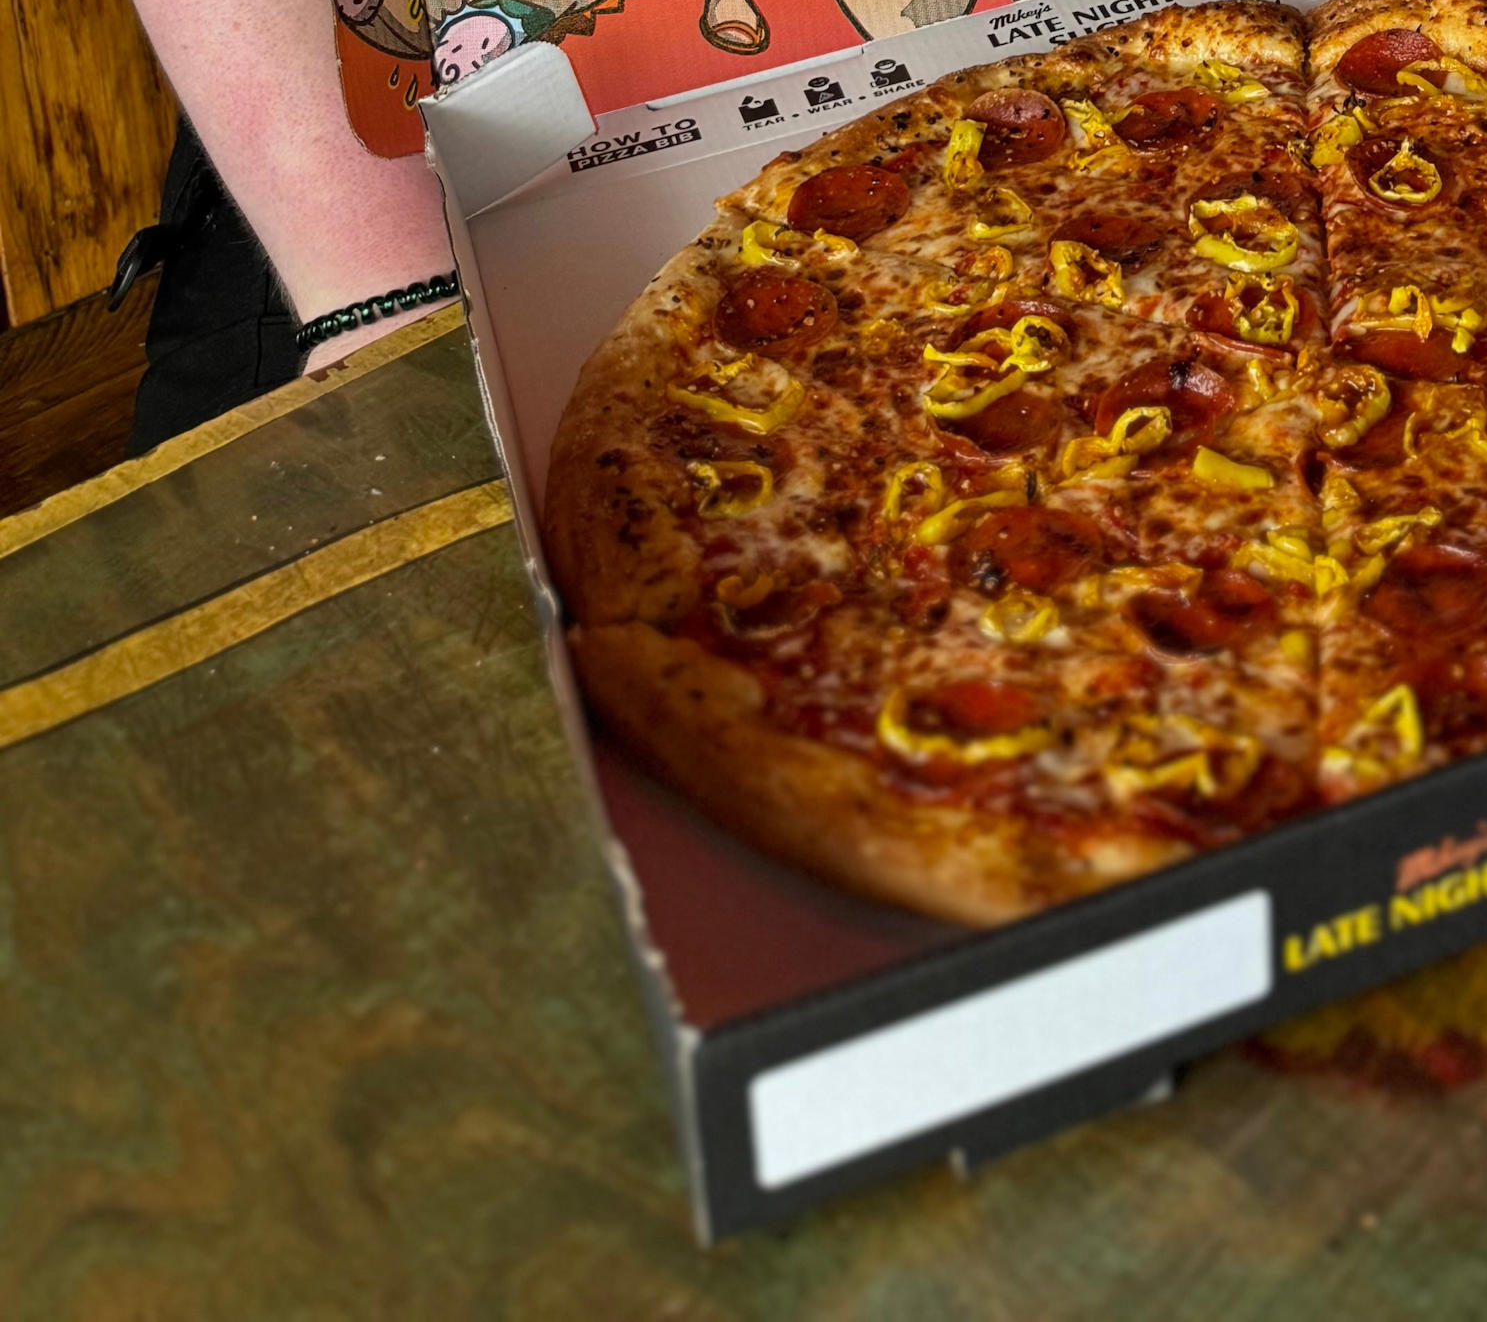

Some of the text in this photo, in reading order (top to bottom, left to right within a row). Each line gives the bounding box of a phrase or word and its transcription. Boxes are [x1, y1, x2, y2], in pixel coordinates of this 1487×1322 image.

[987, 16, 1065, 48] LATE
[989, 2, 1052, 30] Mikey's
[743, 79, 926, 132] TEAR WEAR SHARE
[567, 118, 697, 160] HOW TO
[577, 132, 693, 169] PIZZA BIB
[1284, 904, 1381, 971] LATE
